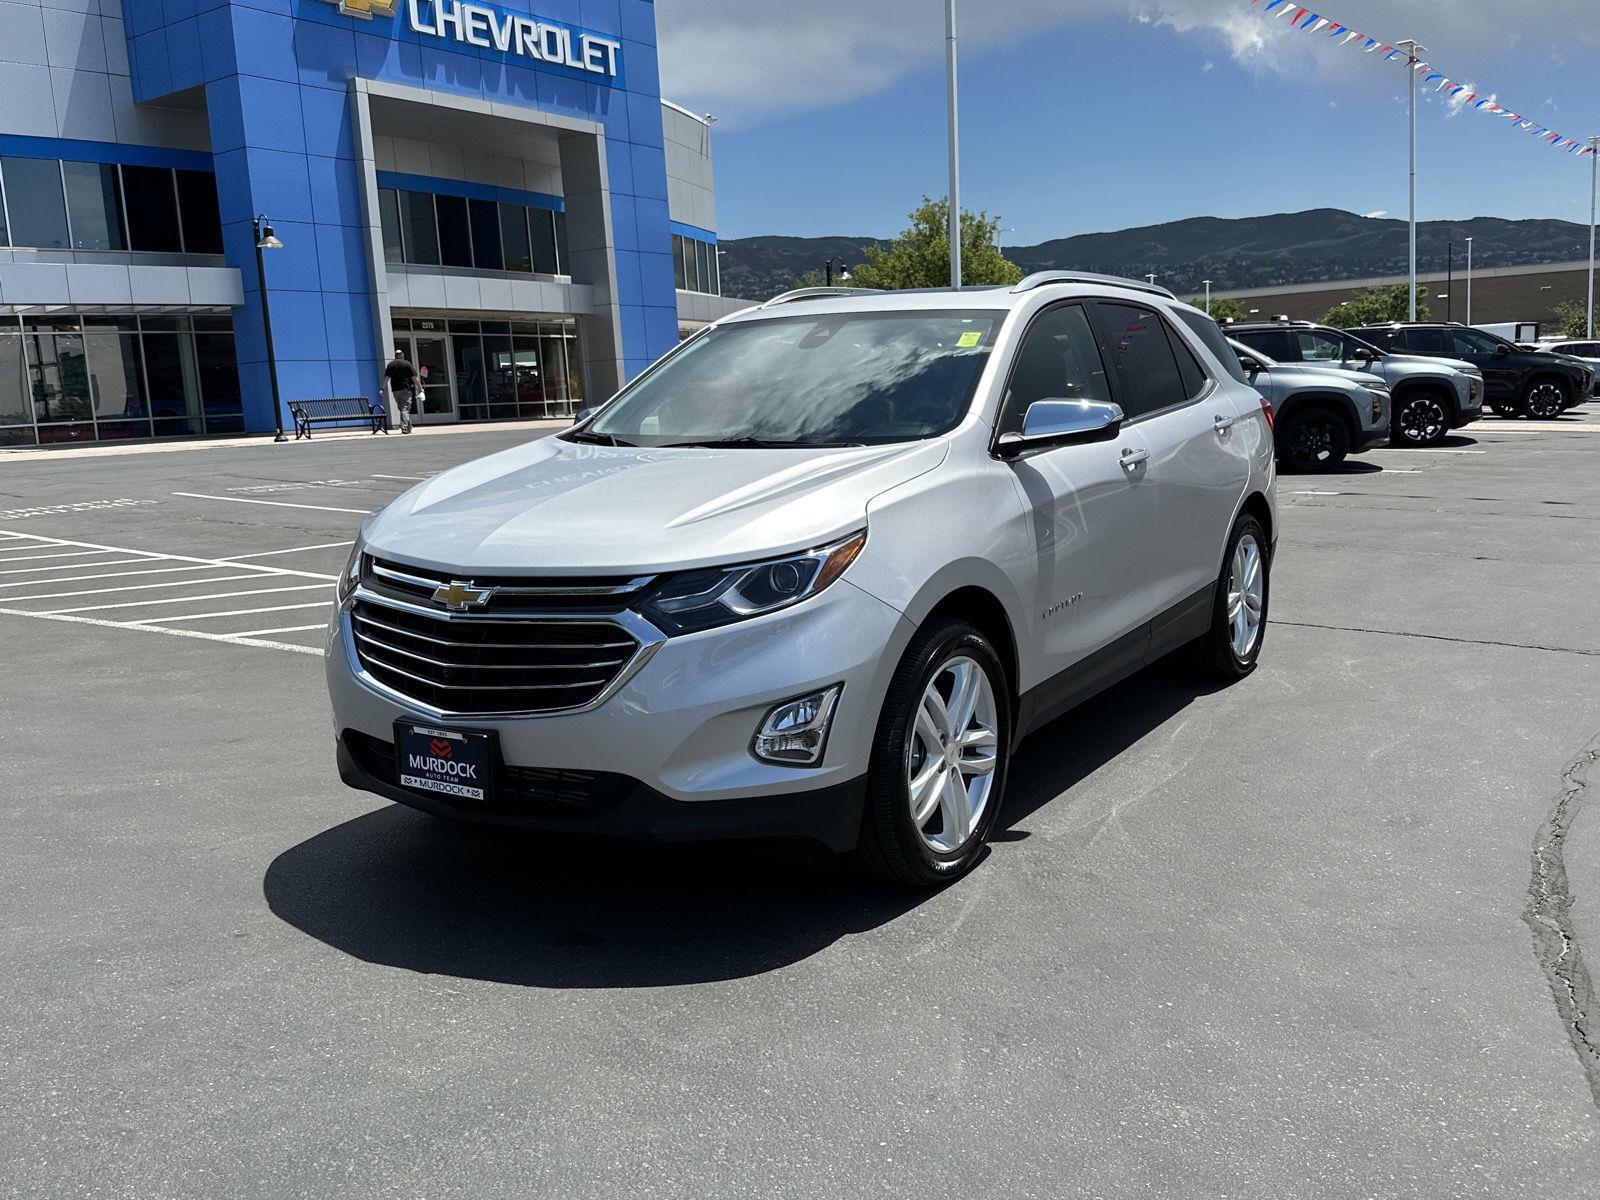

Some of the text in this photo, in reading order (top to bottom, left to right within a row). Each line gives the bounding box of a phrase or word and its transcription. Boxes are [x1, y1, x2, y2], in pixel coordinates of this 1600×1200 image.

[408, 0, 621, 77] CHEVROLET
[409, 754, 477, 779] MURDOCK
[419, 779, 464, 795] MURDOCK
[425, 772, 459, 783] AUTO TEAM
